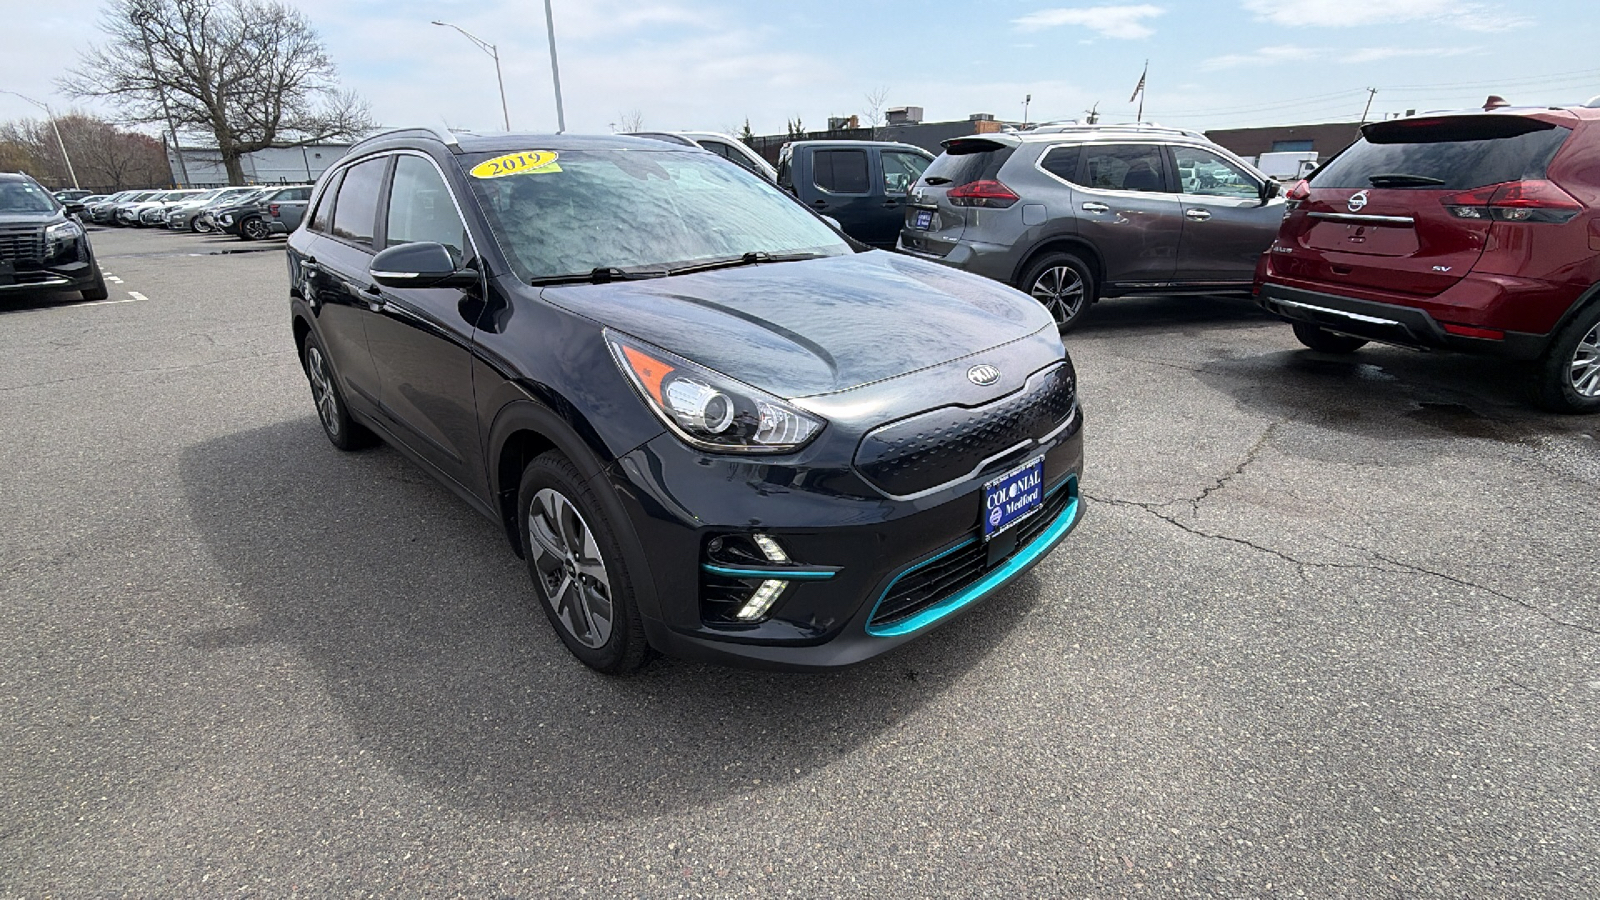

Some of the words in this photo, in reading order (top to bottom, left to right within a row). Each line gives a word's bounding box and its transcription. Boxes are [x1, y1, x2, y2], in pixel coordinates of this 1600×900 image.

[488, 153, 541, 175] 2019
[987, 470, 1041, 509] COLONIAL
[1005, 488, 1039, 516] Medford
